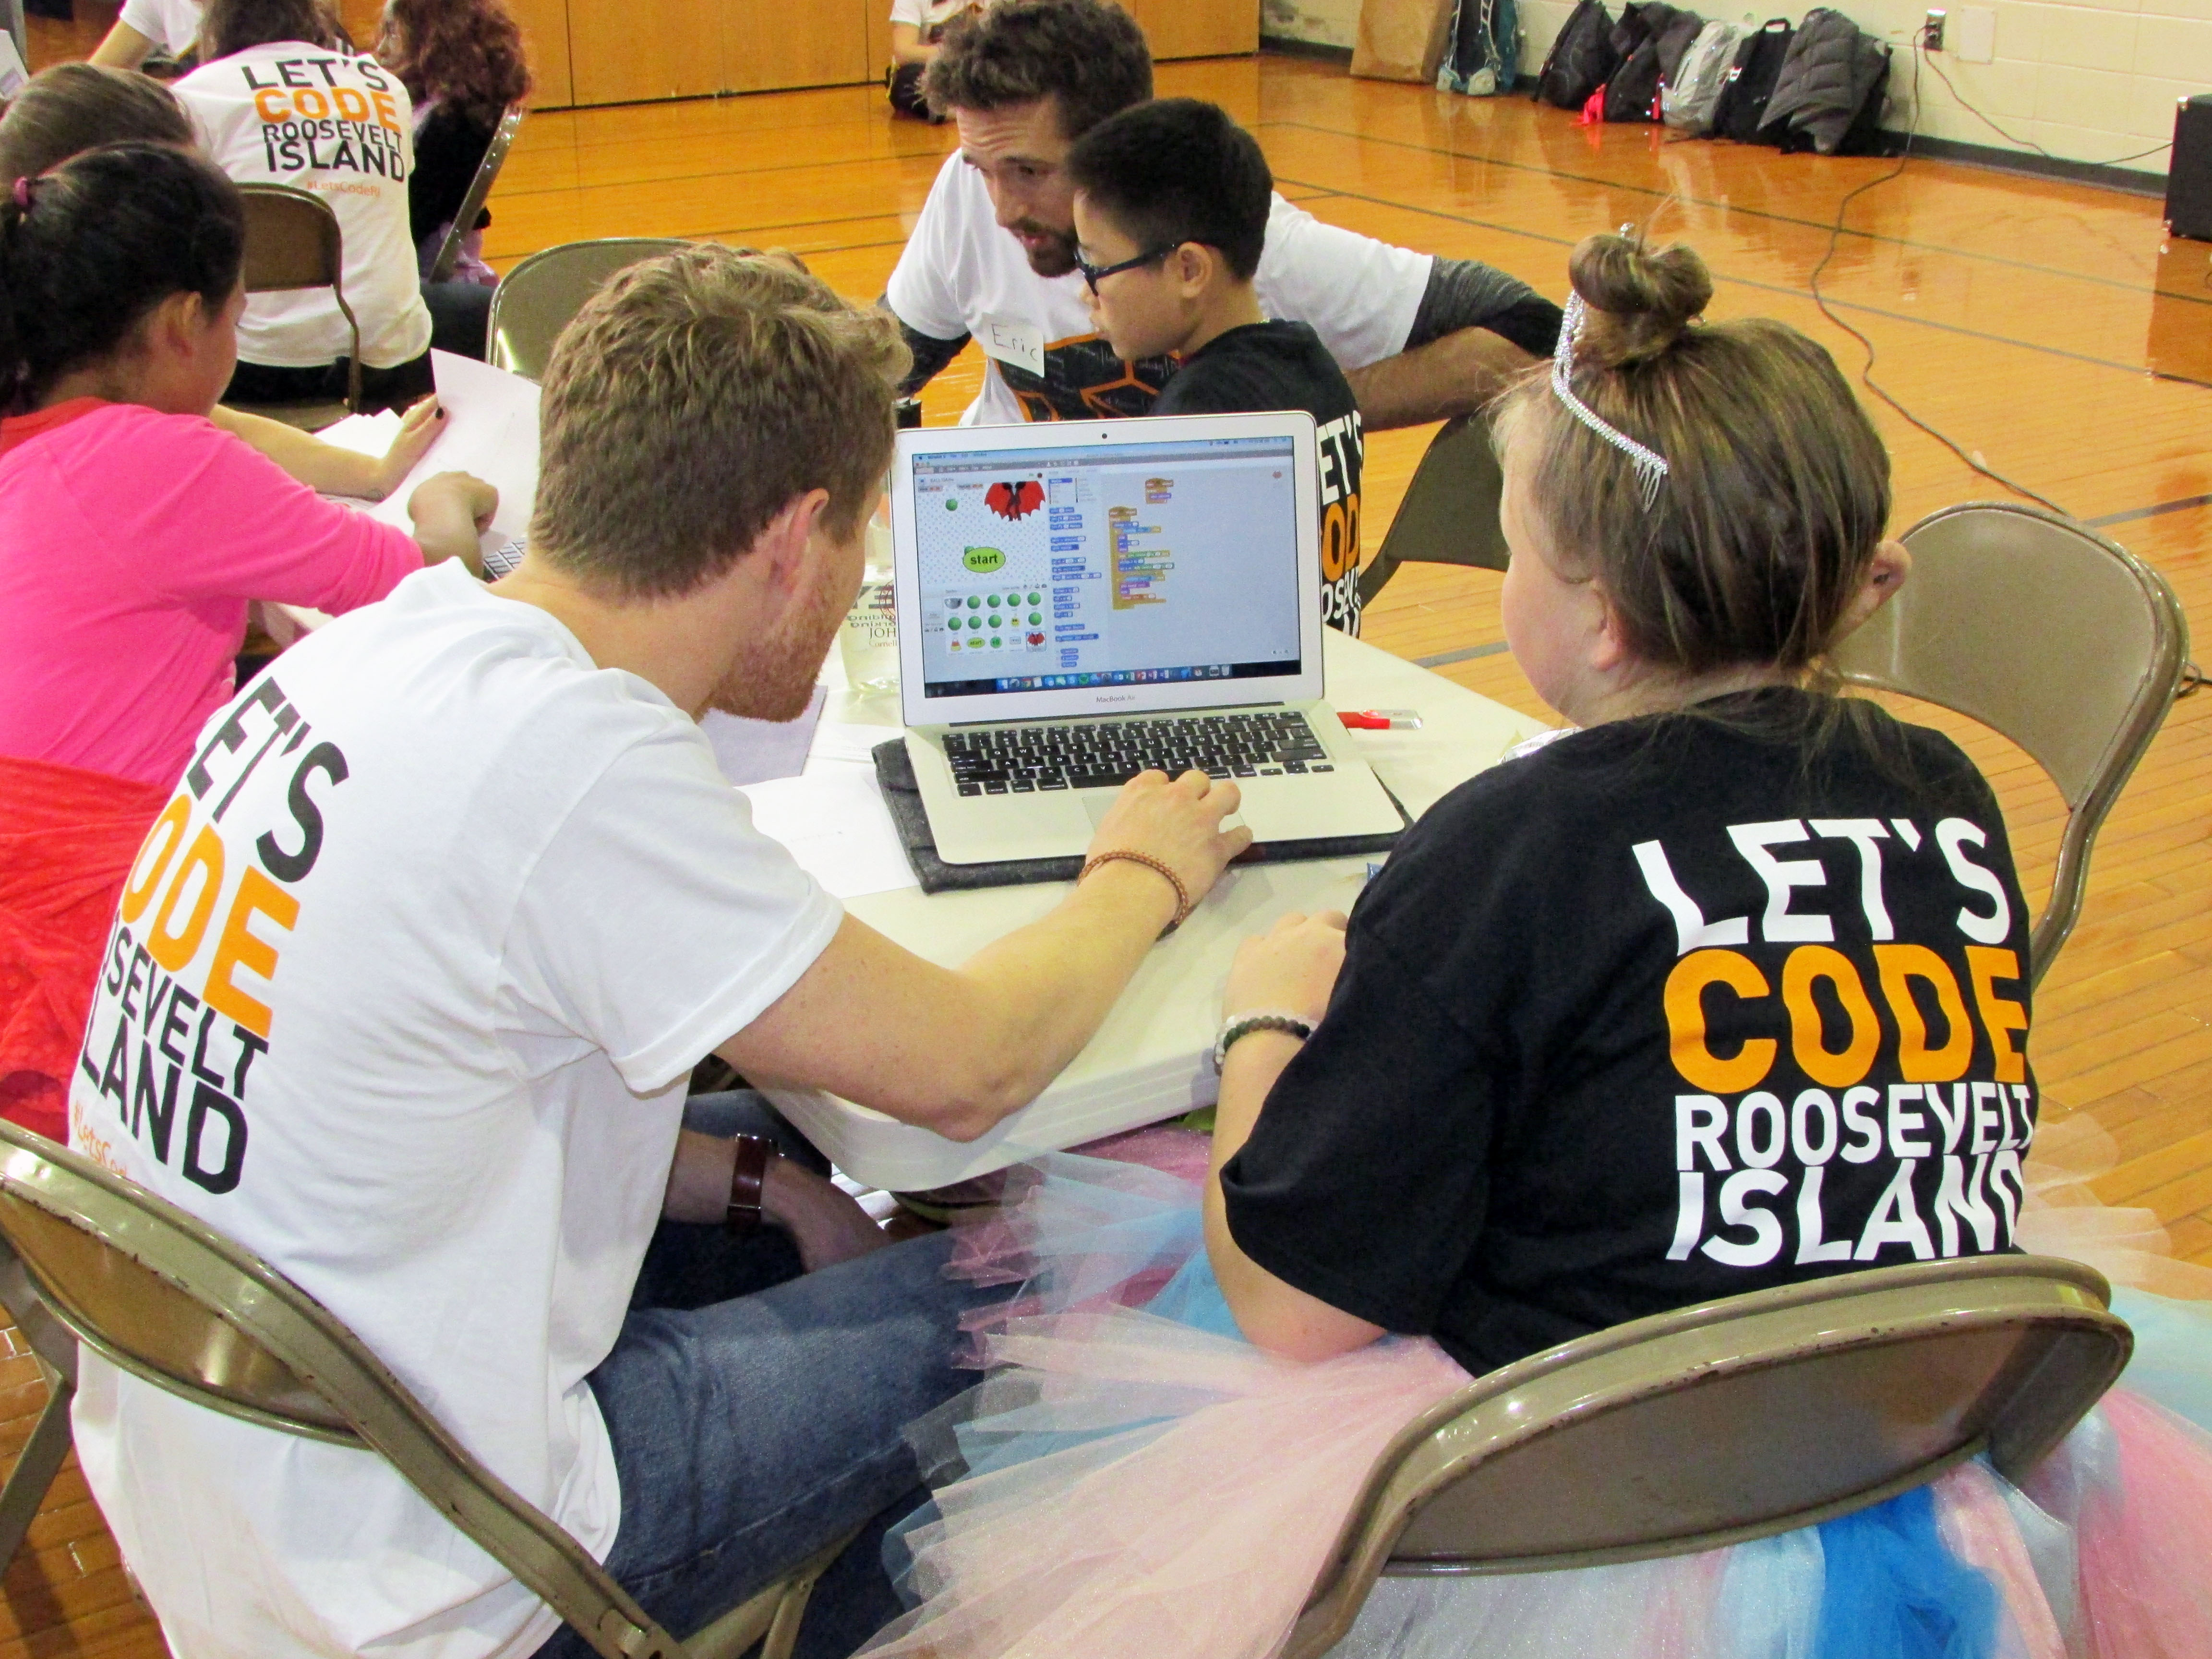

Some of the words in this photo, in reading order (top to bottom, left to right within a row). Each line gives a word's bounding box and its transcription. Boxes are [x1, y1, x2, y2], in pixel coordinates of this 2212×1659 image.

[241, 59, 389, 93] LET'S
[254, 87, 401, 134] CODE
[262, 119, 403, 152] ROOSEVELT
[268, 140, 405, 183] ISLAND
[991, 323, 1038, 362] Eric
[970, 553, 998, 565] start
[1322, 493, 1360, 582] OD
[869, 627, 897, 639] JOH
[869, 639, 897, 647] Cornell
[1096, 695, 1126, 703] MacBook
[186, 675, 349, 882] ET'S
[1631, 817, 2011, 957] LET'S
[121, 793, 301, 1039] ODE
[102, 910, 269, 1101] SEVELT
[1663, 944, 2028, 1094] CODE
[81, 979, 248, 1195] LAND
[1674, 1081, 2035, 1172] ROOSEVELT
